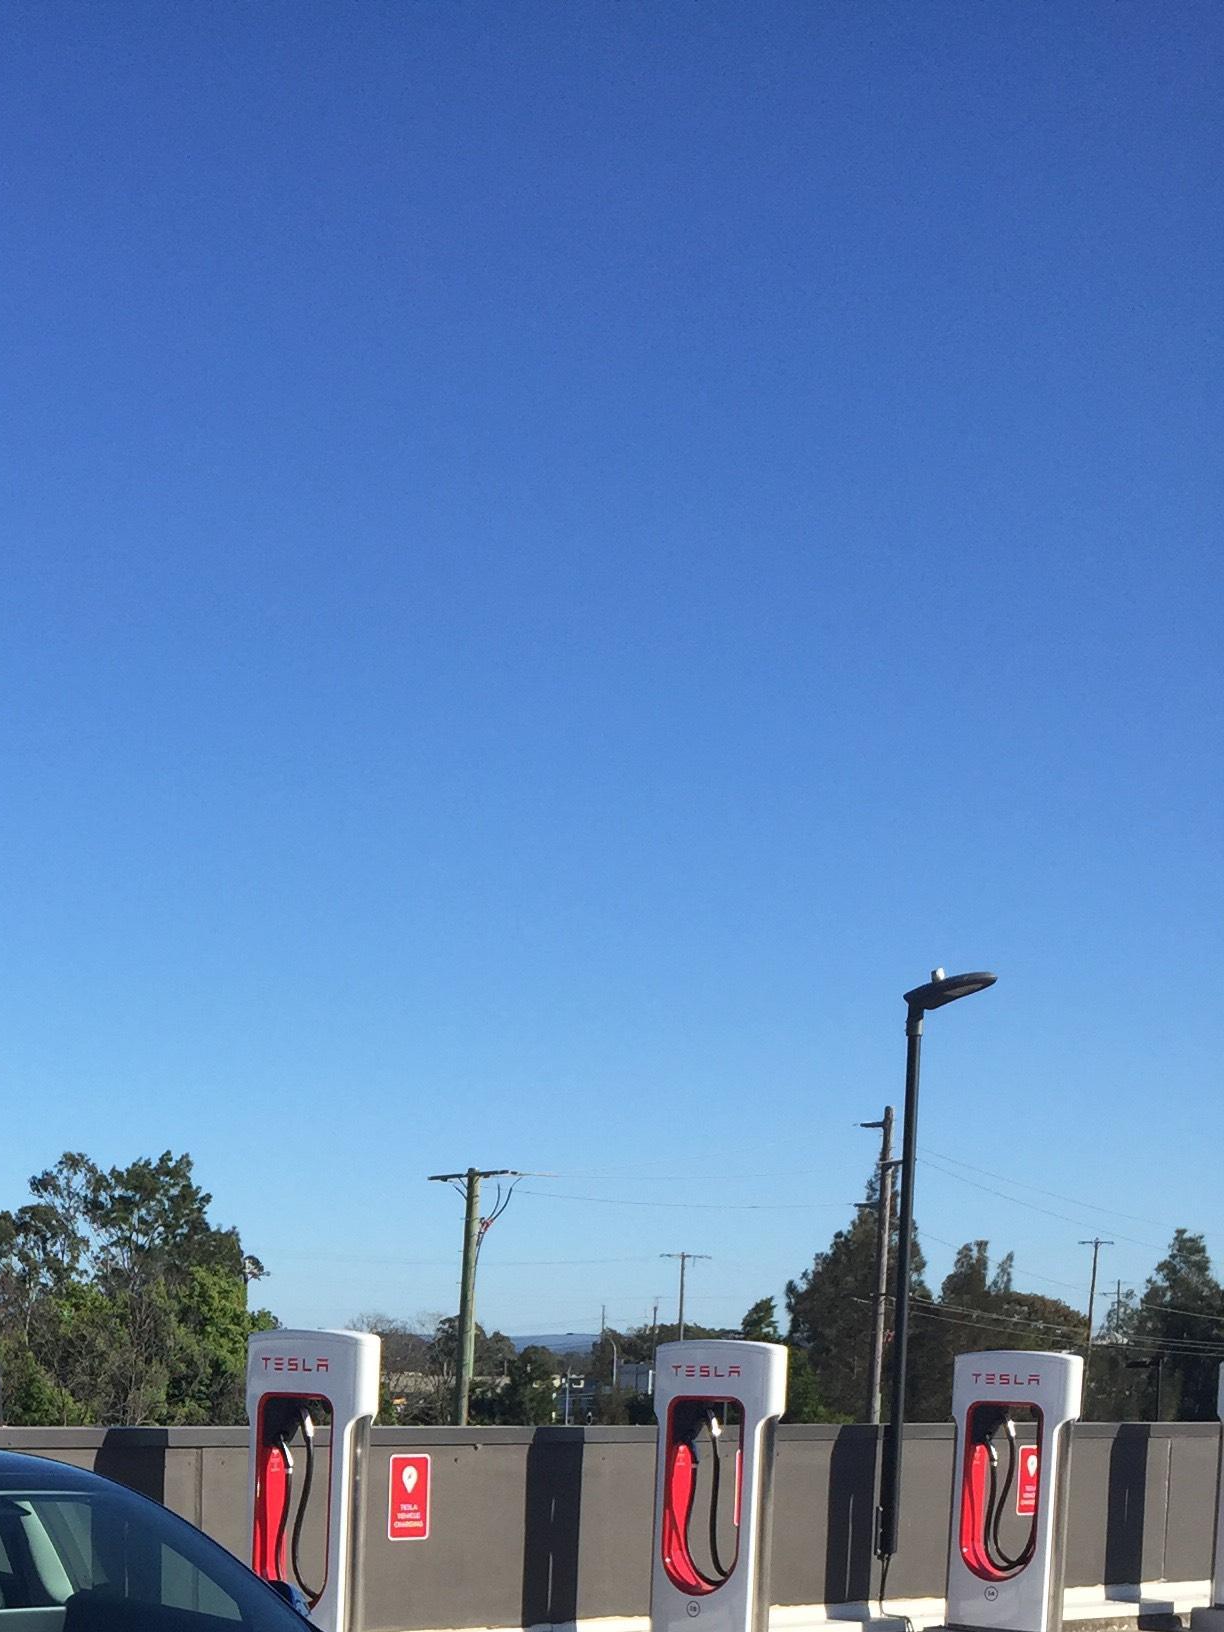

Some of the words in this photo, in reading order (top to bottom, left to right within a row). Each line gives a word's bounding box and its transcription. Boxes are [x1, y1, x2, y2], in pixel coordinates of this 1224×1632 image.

[261, 1356, 329, 1373] TESLA
[671, 1364, 741, 1378] TESLA
[971, 1372, 1041, 1386] TESLA
